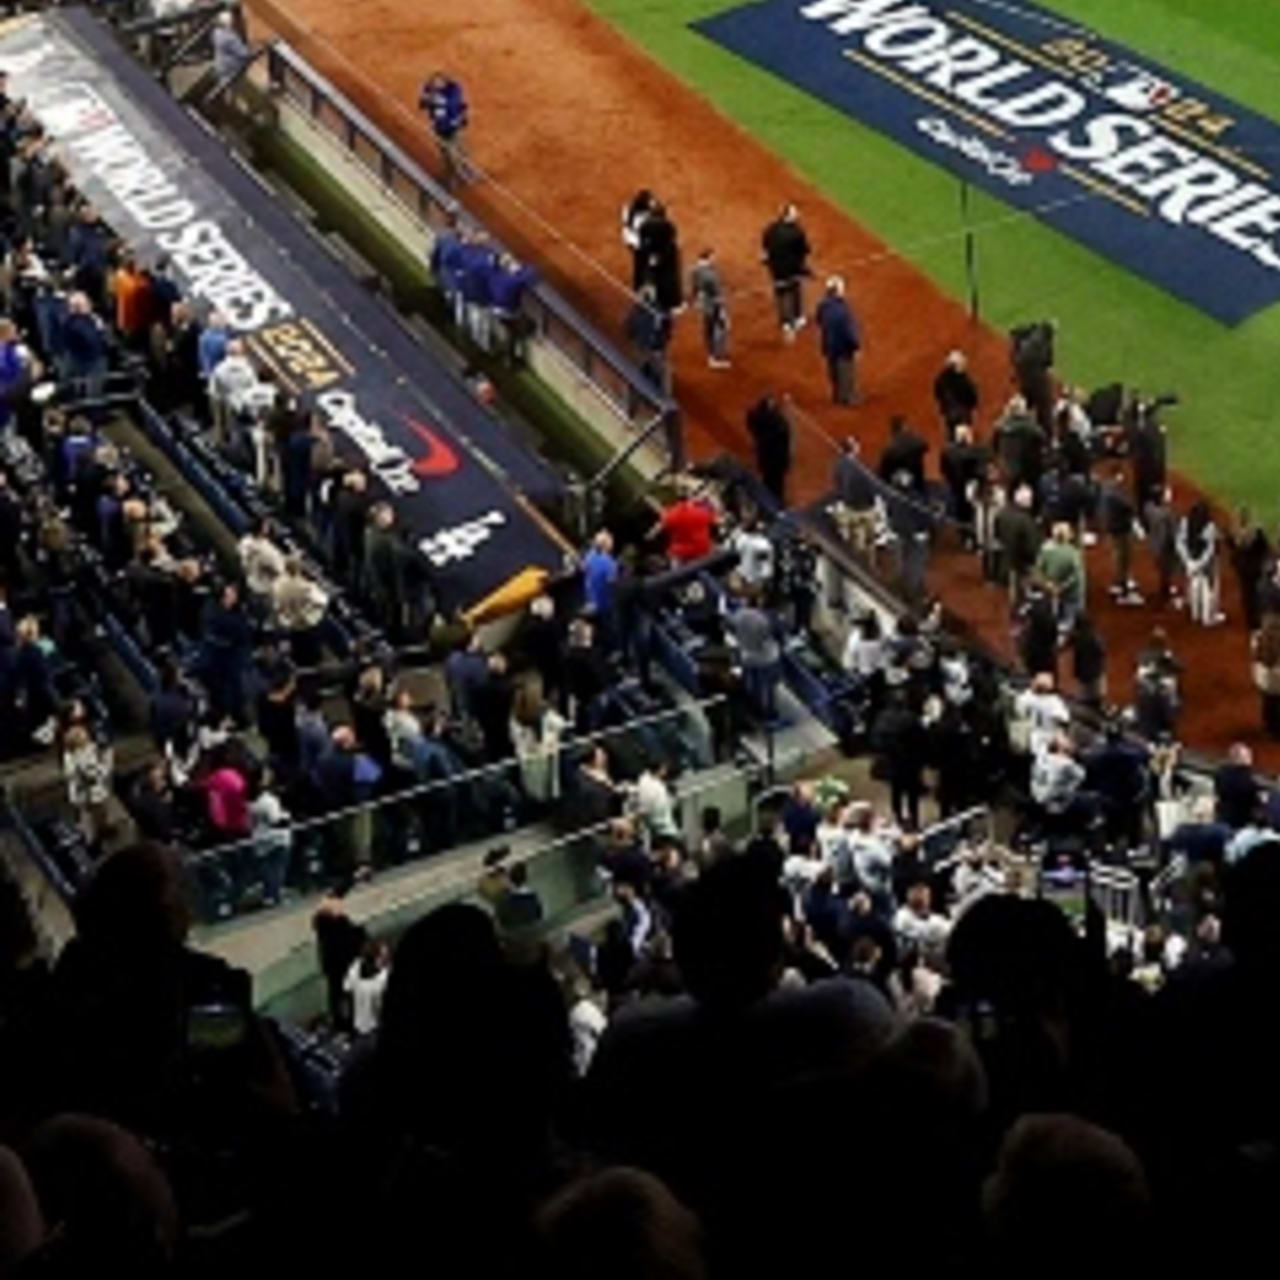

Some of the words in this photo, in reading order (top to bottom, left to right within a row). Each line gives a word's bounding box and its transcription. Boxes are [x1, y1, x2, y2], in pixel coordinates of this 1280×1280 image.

[70, 130, 196, 232] WORLD
[156, 219, 294, 330] SERIES
[260, 322, 347, 391] 2024
